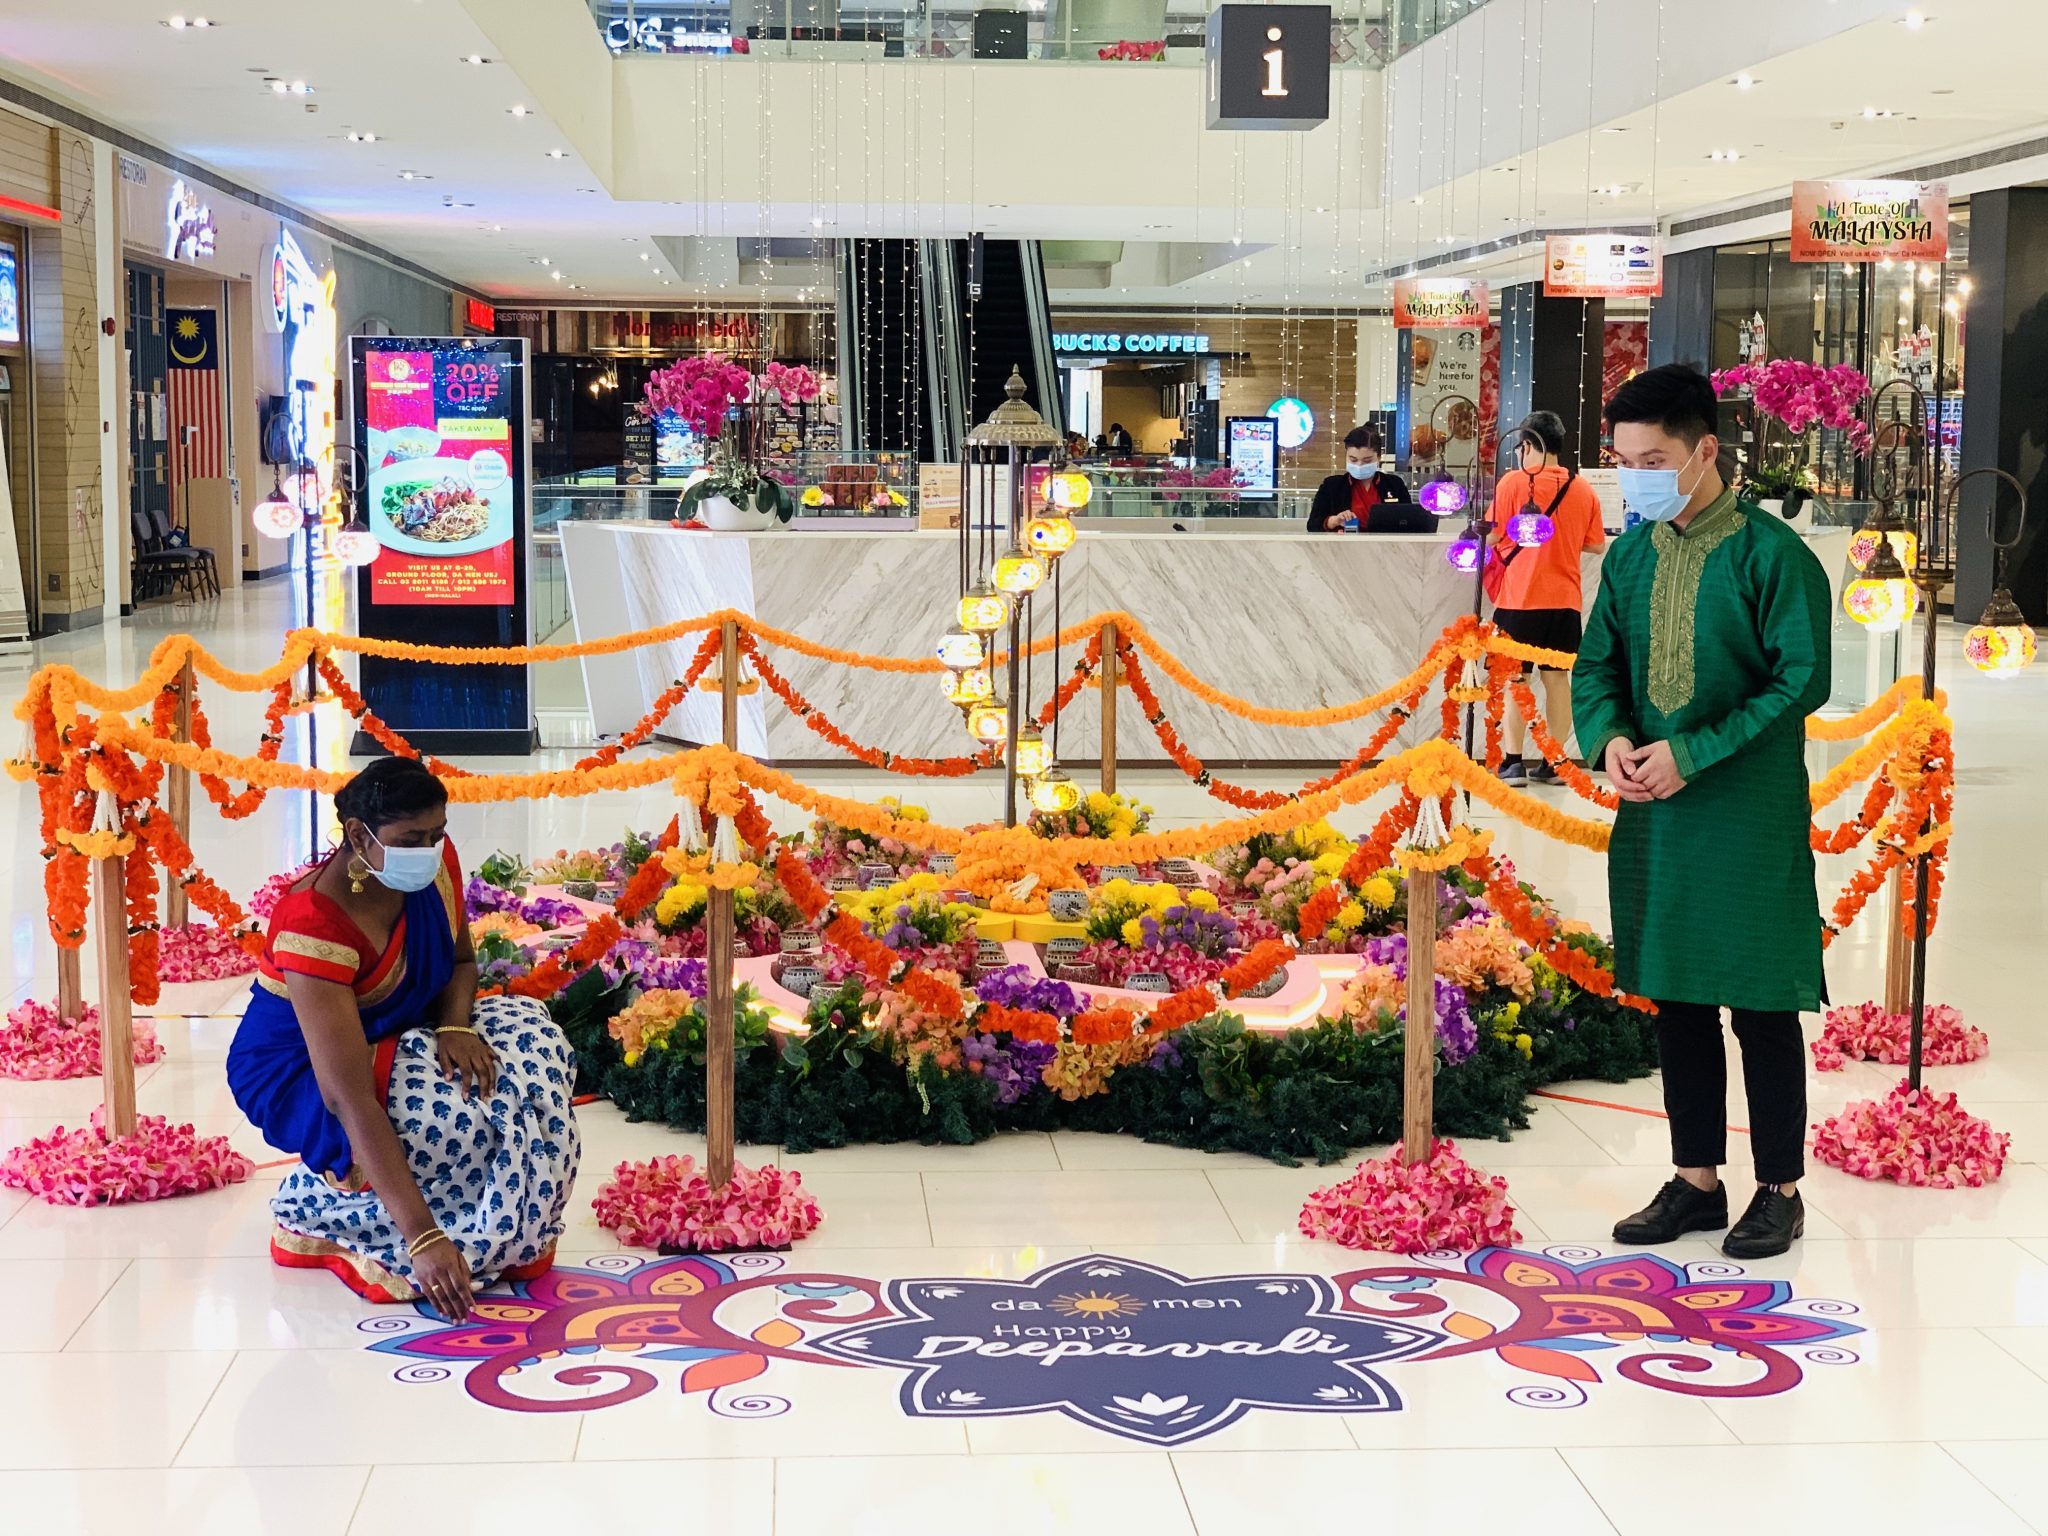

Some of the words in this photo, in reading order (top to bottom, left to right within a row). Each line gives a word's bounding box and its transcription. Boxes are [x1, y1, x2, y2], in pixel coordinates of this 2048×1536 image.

[1261, 27, 1289, 96] i
[120, 157, 147, 185] RESTORAN
[1834, 201, 1846, 216] A
[1849, 201, 1886, 216] Taste
[1888, 201, 1906, 218] Of
[1809, 220, 1932, 246] MALAYSIA
[496, 312, 540, 322] RESTORAN
[1125, 334, 1209, 352] COFFEE
[446, 363, 499, 382] 20%
[1439, 361, 1467, 370] We're
[1439, 371, 1460, 381] here
[1461, 371, 1474, 381] for
[446, 383, 499, 402] OFF
[991, 1299, 1043, 1311] da
[1153, 1298, 1242, 1309] men
[993, 1324, 1132, 1341] Happy
[912, 1327, 1351, 1367] Deepavali
